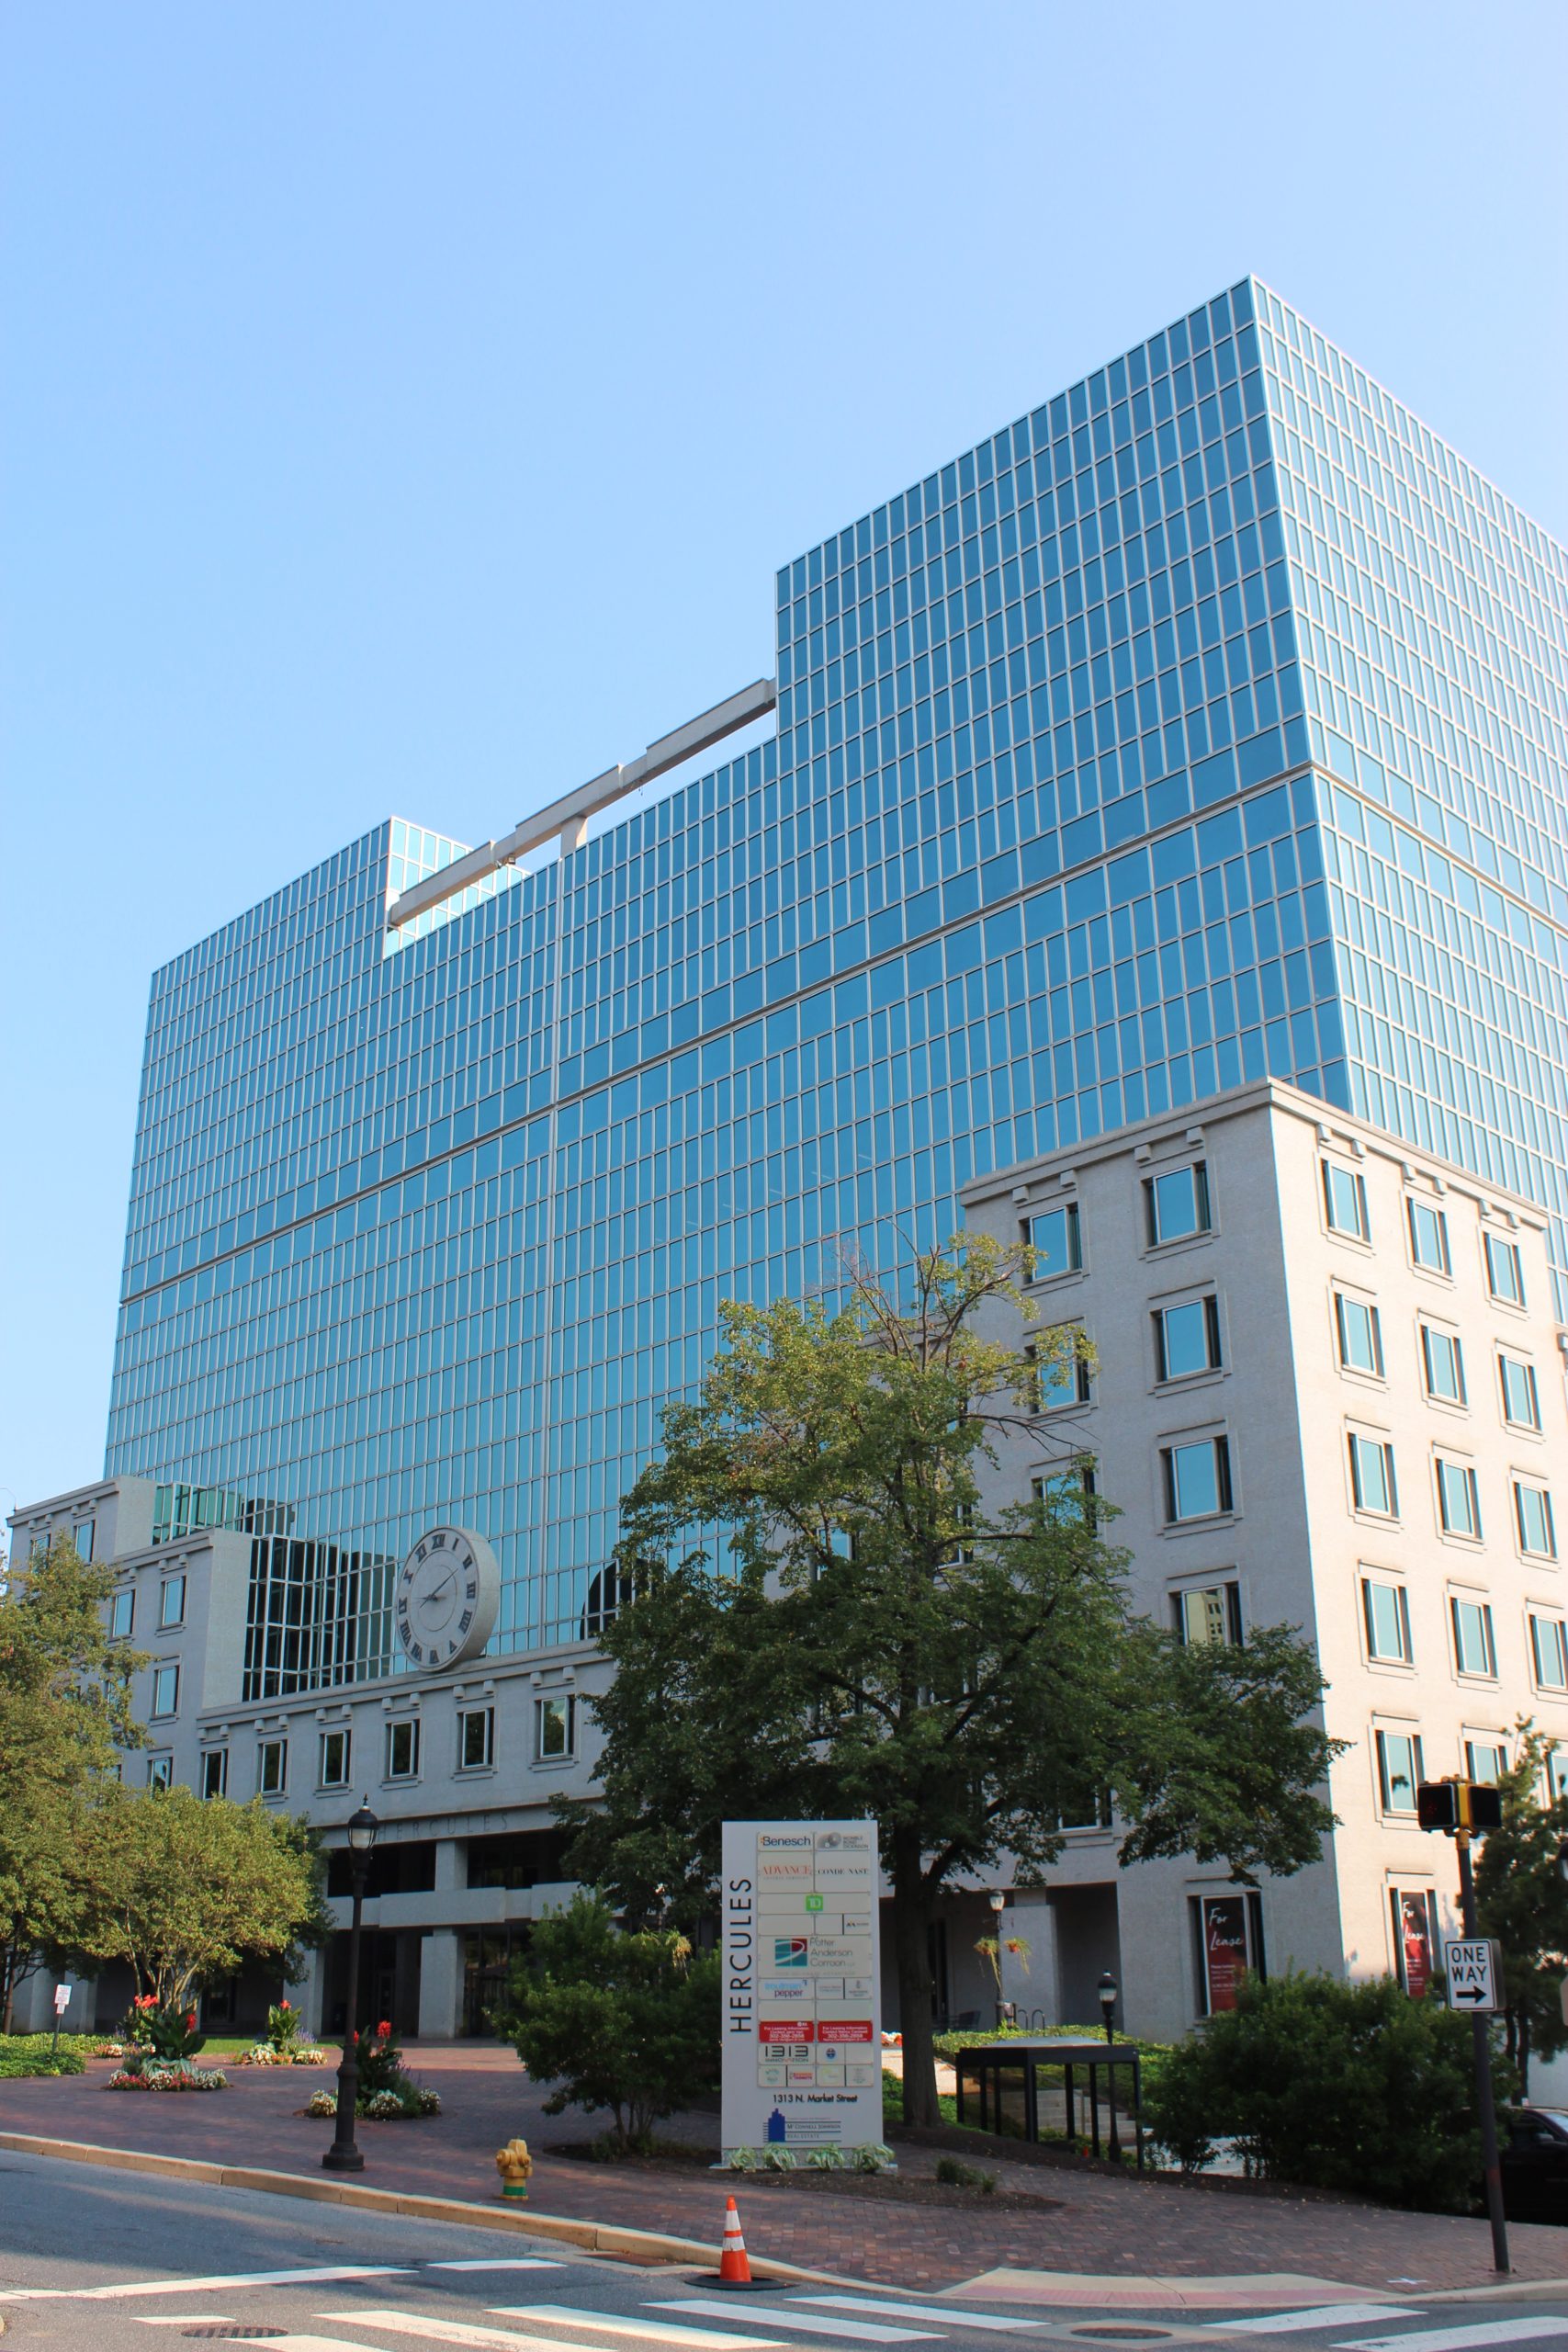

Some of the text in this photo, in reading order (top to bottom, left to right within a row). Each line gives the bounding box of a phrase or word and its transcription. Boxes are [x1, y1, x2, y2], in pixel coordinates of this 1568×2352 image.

[378, 1813, 508, 1842] HERCULES
[762, 1836, 811, 1847] Benesch
[763, 1866, 811, 1875] ADVANCE
[1209, 1906, 1229, 1926] For
[809, 1937, 835, 1947] Potter
[1209, 1930, 1244, 1951] Lease
[730, 1879, 751, 2032] HERCULES
[810, 1948, 852, 1956] Anderson
[1451, 1946, 1484, 1962] ONE
[810, 1958, 846, 1967] Corroon
[1452, 1966, 1487, 1983] WAY
[774, 1989, 804, 1997] pepper
[765, 2045, 808, 2057] 1313
[773, 2093, 858, 2103] 1313 N. Market Street
